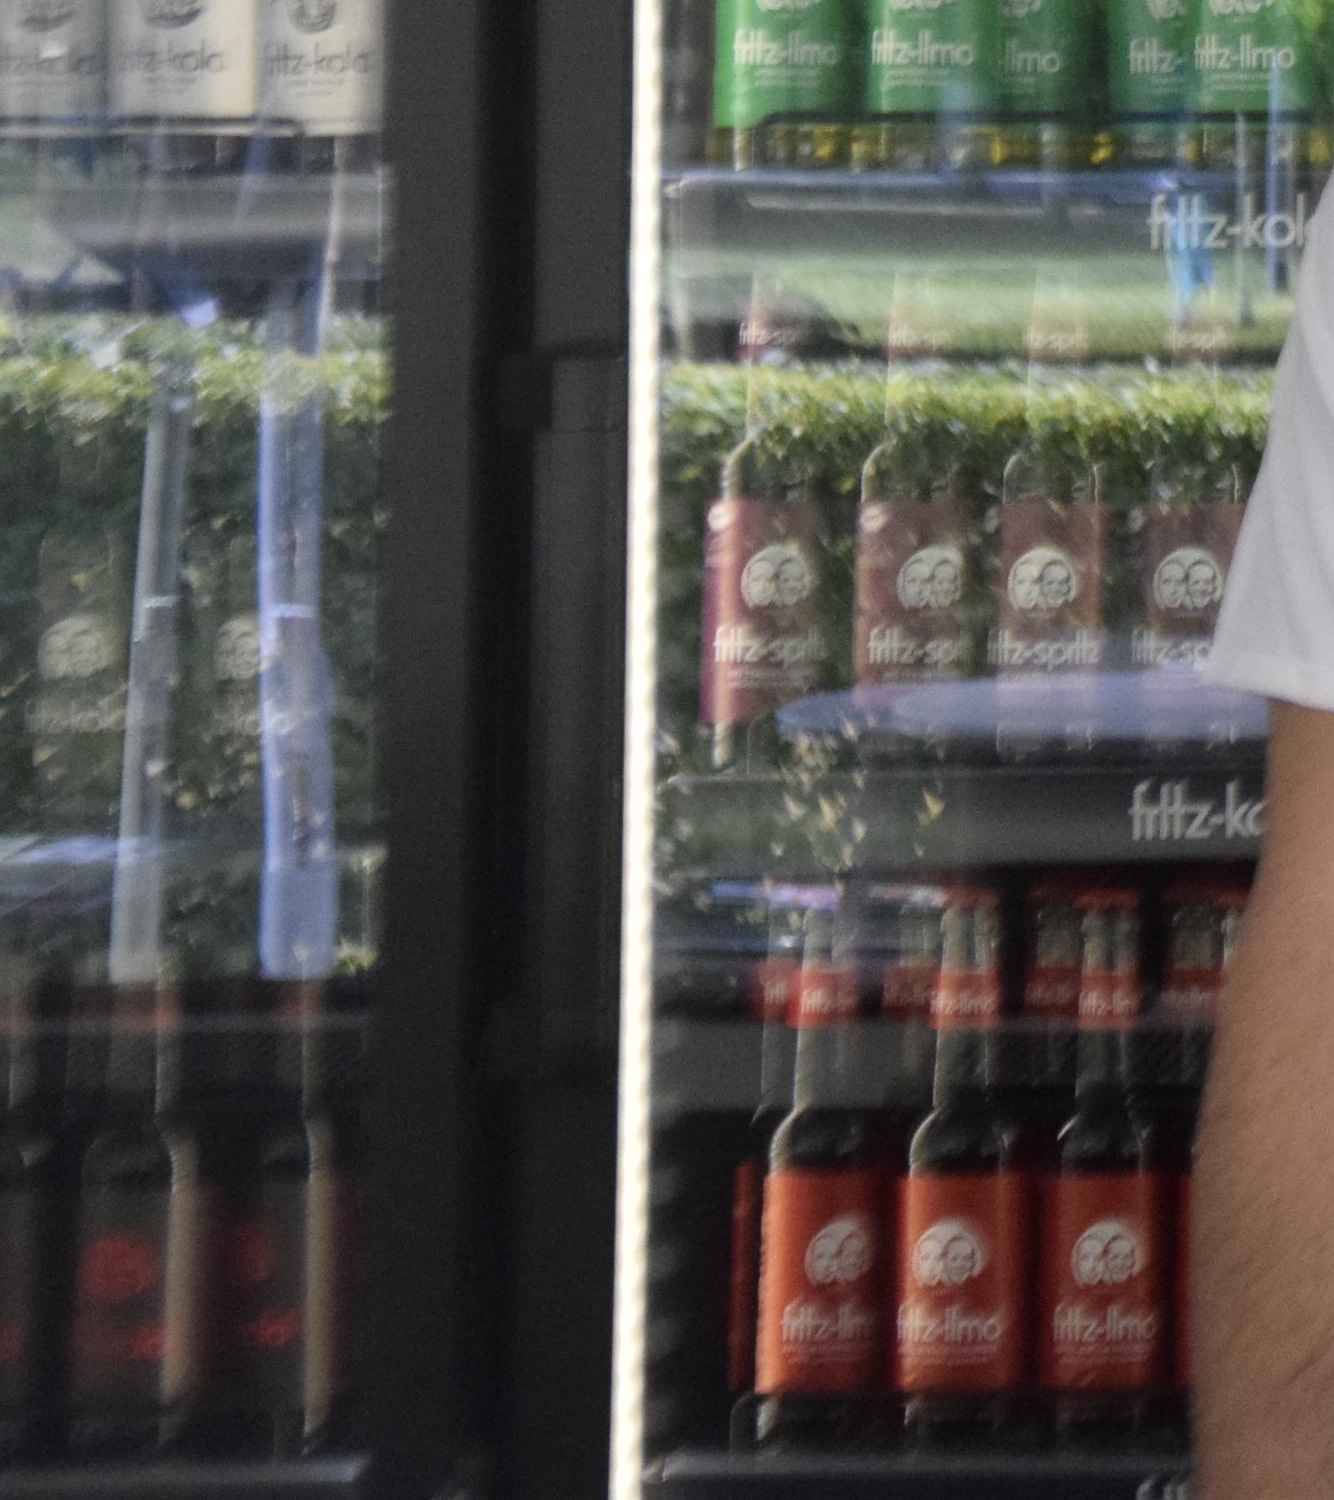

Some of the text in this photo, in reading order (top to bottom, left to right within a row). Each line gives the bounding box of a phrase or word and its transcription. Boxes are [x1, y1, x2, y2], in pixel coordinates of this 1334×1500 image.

[871, 28, 976, 68] fritz-limo
[1194, 33, 1296, 71] fritz-limo
[1146, 192, 1306, 251] fritz-kol
